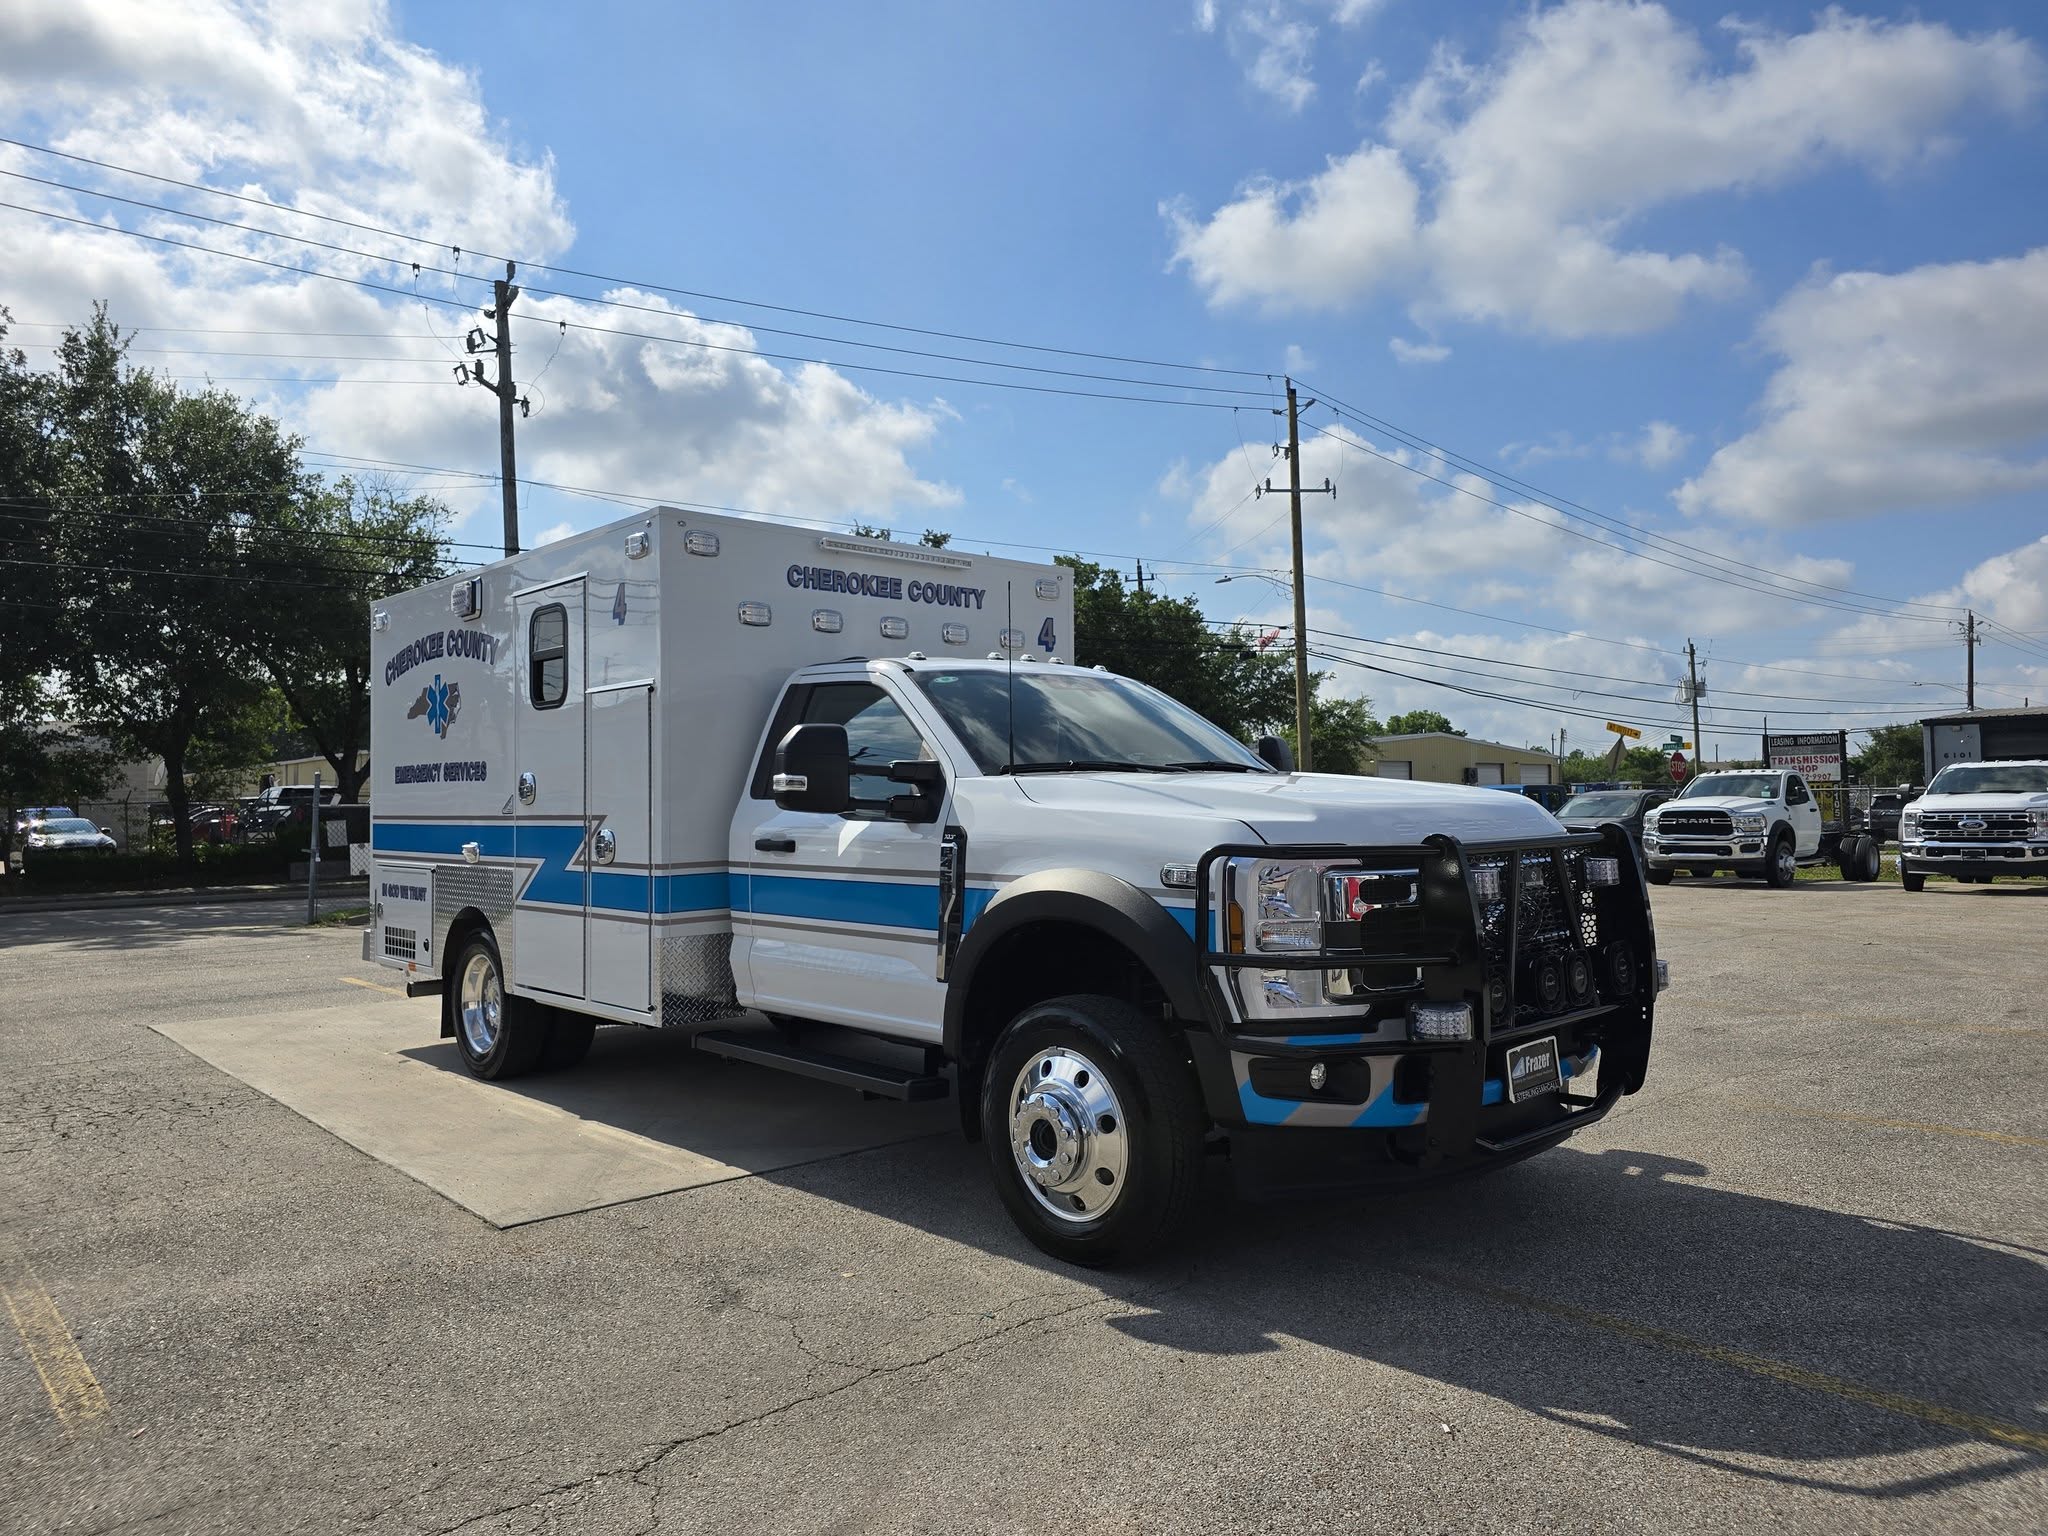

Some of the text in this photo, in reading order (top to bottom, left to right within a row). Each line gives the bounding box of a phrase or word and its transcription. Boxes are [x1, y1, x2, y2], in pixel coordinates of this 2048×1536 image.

[787, 564, 986, 610] CHEROKEE COUNTY
[612, 582, 628, 626] 4
[1038, 617, 1056, 652] 4
[385, 629, 500, 687] CHEROKEE COUNTY
[1771, 735, 1838, 746] LEASING INFORMATION
[1671, 761, 1686, 773] STOP
[1771, 755, 1840, 766] TRANSMISSION
[1792, 765, 1818, 774] SHOP
[395, 761, 487, 784] EMERGENCY SERVICES
[1525, 1053, 1550, 1073] Frazer
